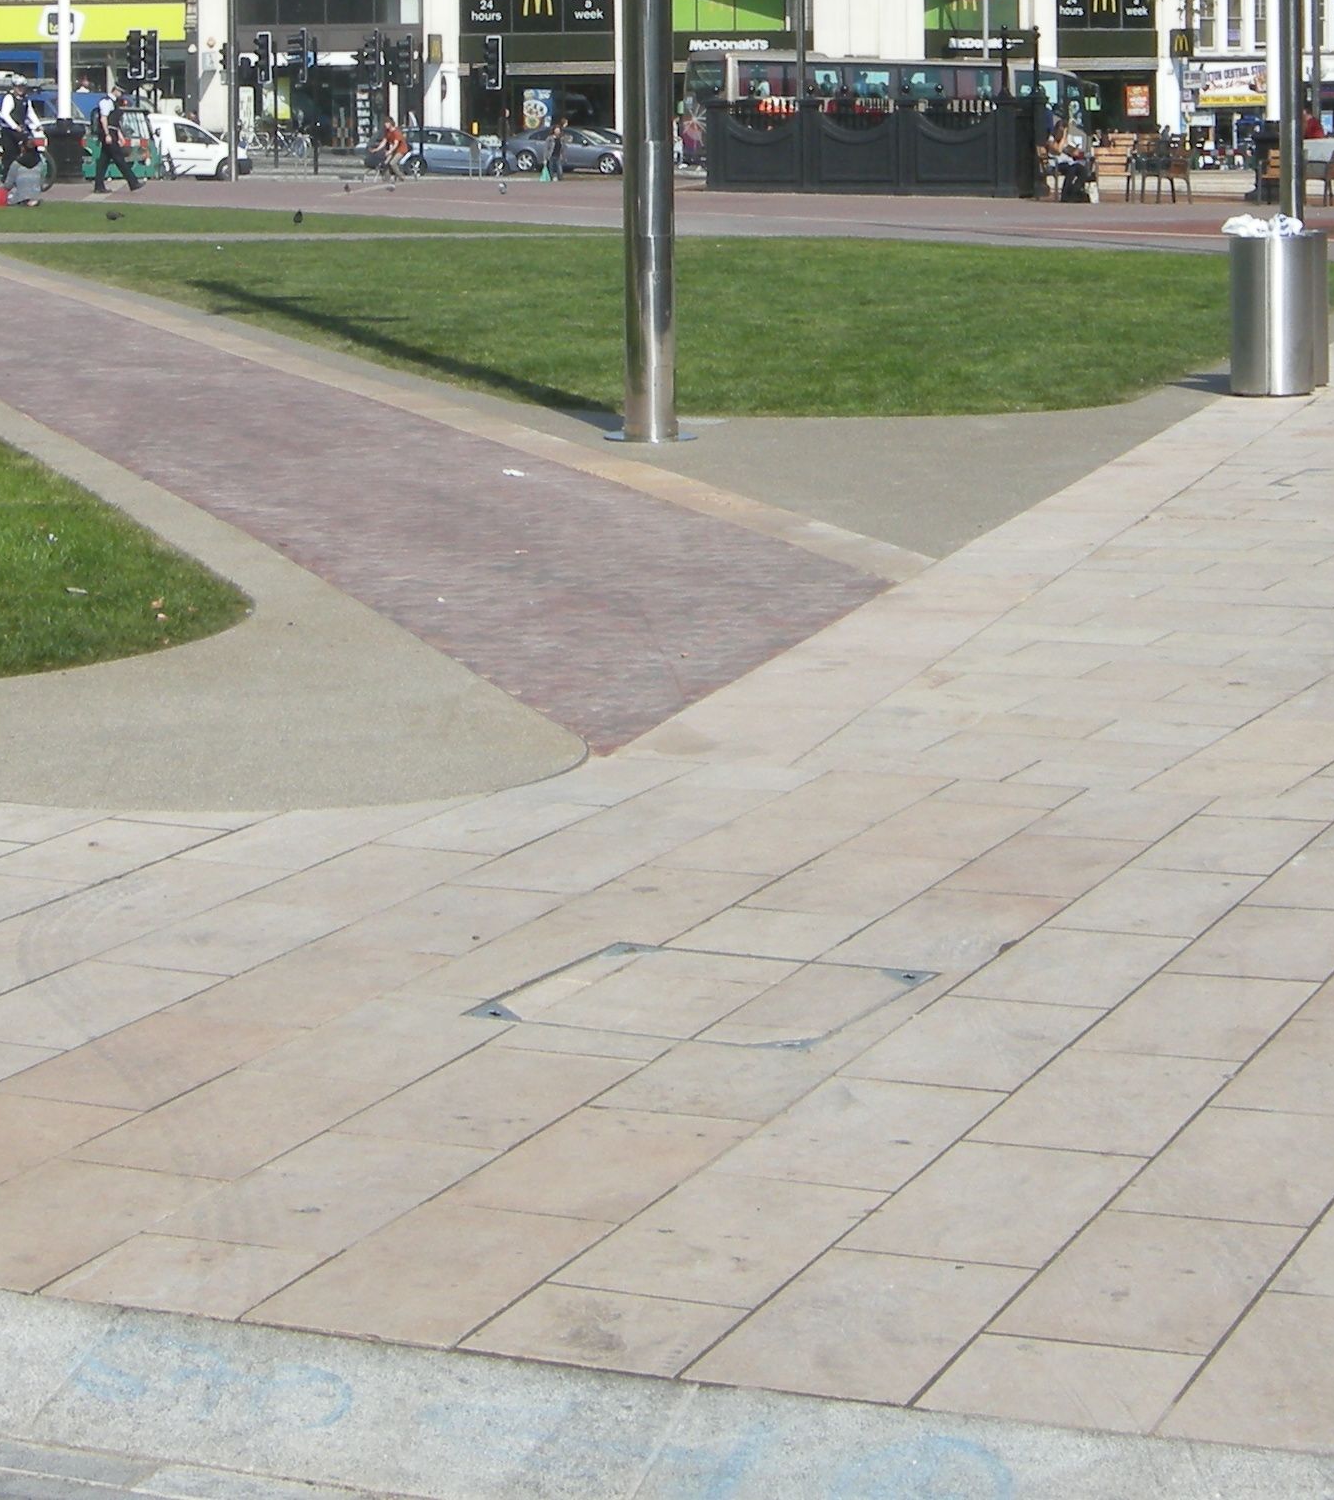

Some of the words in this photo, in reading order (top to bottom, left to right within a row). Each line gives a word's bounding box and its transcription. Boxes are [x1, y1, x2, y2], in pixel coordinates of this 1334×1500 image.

[480, 0, 494, 10] 24
[471, 11, 502, 21] hours
[574, 9, 604, 20] week
[1059, 6, 1084, 16] hours
[1126, 6, 1148, 16] week
[689, 39, 769, 51] McDonald's
